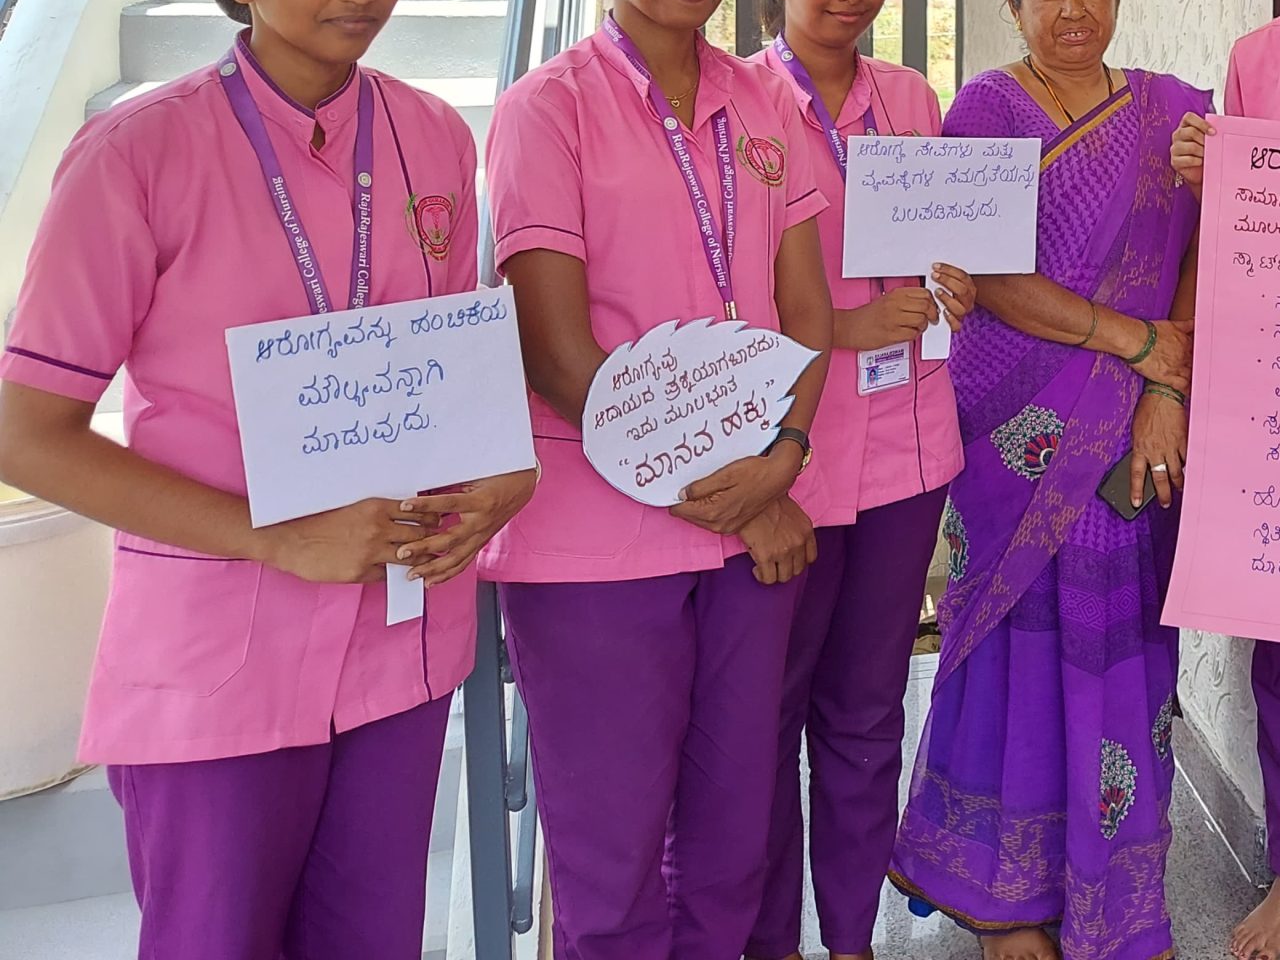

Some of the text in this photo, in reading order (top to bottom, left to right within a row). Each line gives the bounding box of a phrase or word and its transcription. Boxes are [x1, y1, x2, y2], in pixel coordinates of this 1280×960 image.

[714, 116, 729, 152] Nursing
[829, 128, 847, 162] Nursing
[982, 141, 1014, 160] ಮತ್ತು
[718, 152, 730, 163] of
[722, 163, 735, 200] College
[271, 175, 315, 278] College of Nursing
[672, 133, 727, 288] RajaRajeswari College of Nursing
[357, 192, 371, 268] RajaRajeswari
[256, 316, 398, 363] ಆರೋಗ್ಯವನ್ನು
